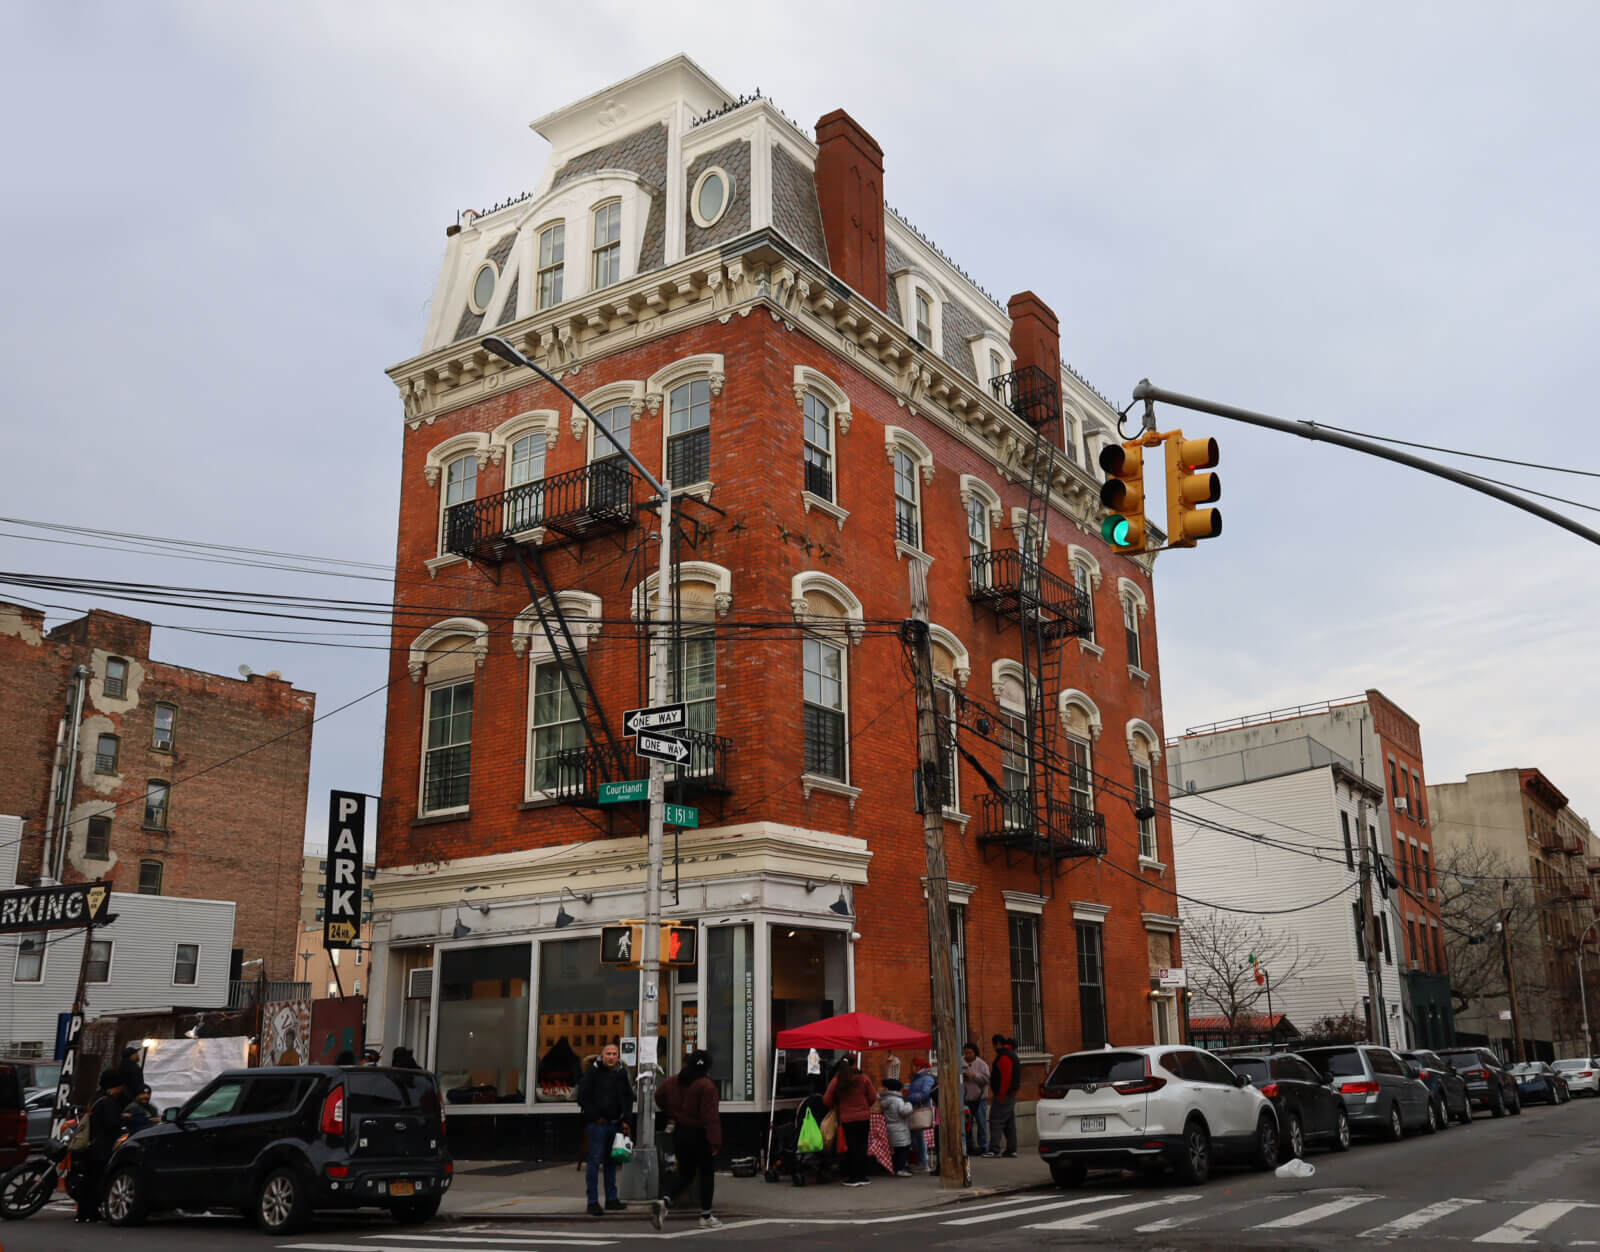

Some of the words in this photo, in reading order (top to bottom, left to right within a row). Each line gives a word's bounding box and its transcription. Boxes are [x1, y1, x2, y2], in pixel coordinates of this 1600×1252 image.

[633, 716, 650, 728] ONE
[659, 711, 677, 724] WAY
[645, 739, 661, 752] ONE
[668, 743, 683, 755] WAY
[606, 783, 642, 795] Courtlandt
[666, 806, 672, 822] E
[675, 807, 686, 824] 151
[332, 797, 359, 916] PARK
[1, 891, 84, 924] RKING
[330, 924, 341, 939] 24
[50, 1015, 82, 1141] PARK
